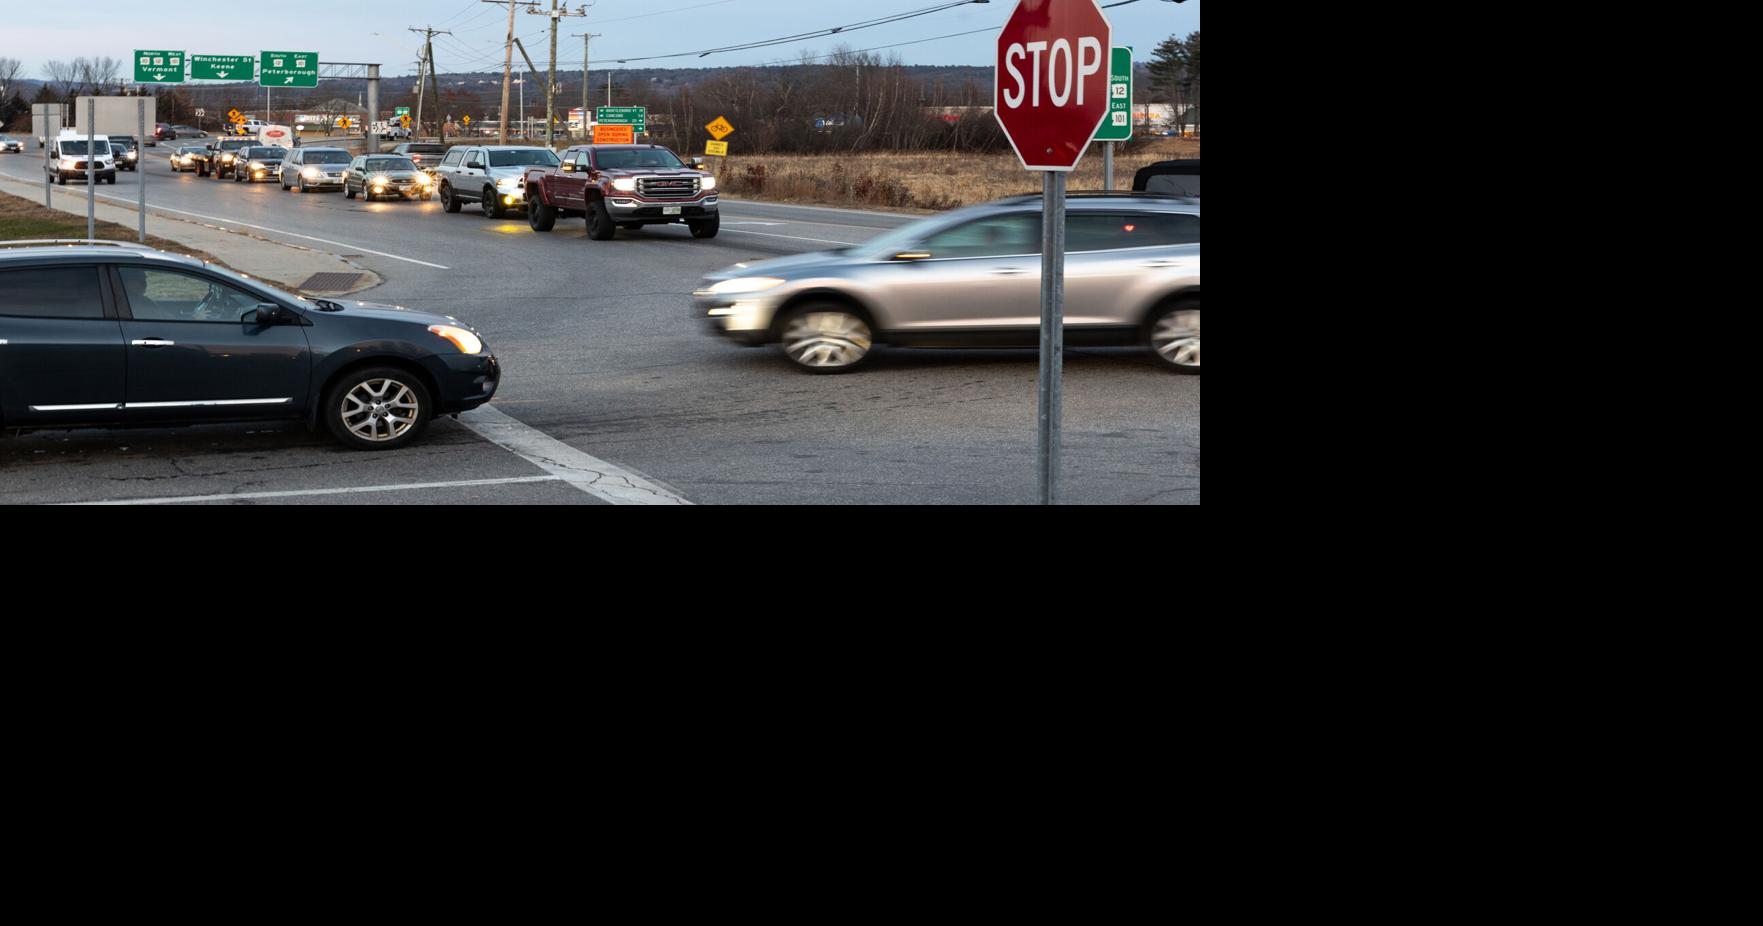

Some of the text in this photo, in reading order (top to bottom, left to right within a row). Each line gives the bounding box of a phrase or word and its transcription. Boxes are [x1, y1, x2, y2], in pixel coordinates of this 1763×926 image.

[1003, 36, 1102, 109] STOP
[1111, 74, 1129, 82] SOUTH
[1115, 86, 1125, 95] 12
[1115, 114, 1125, 123] 101
